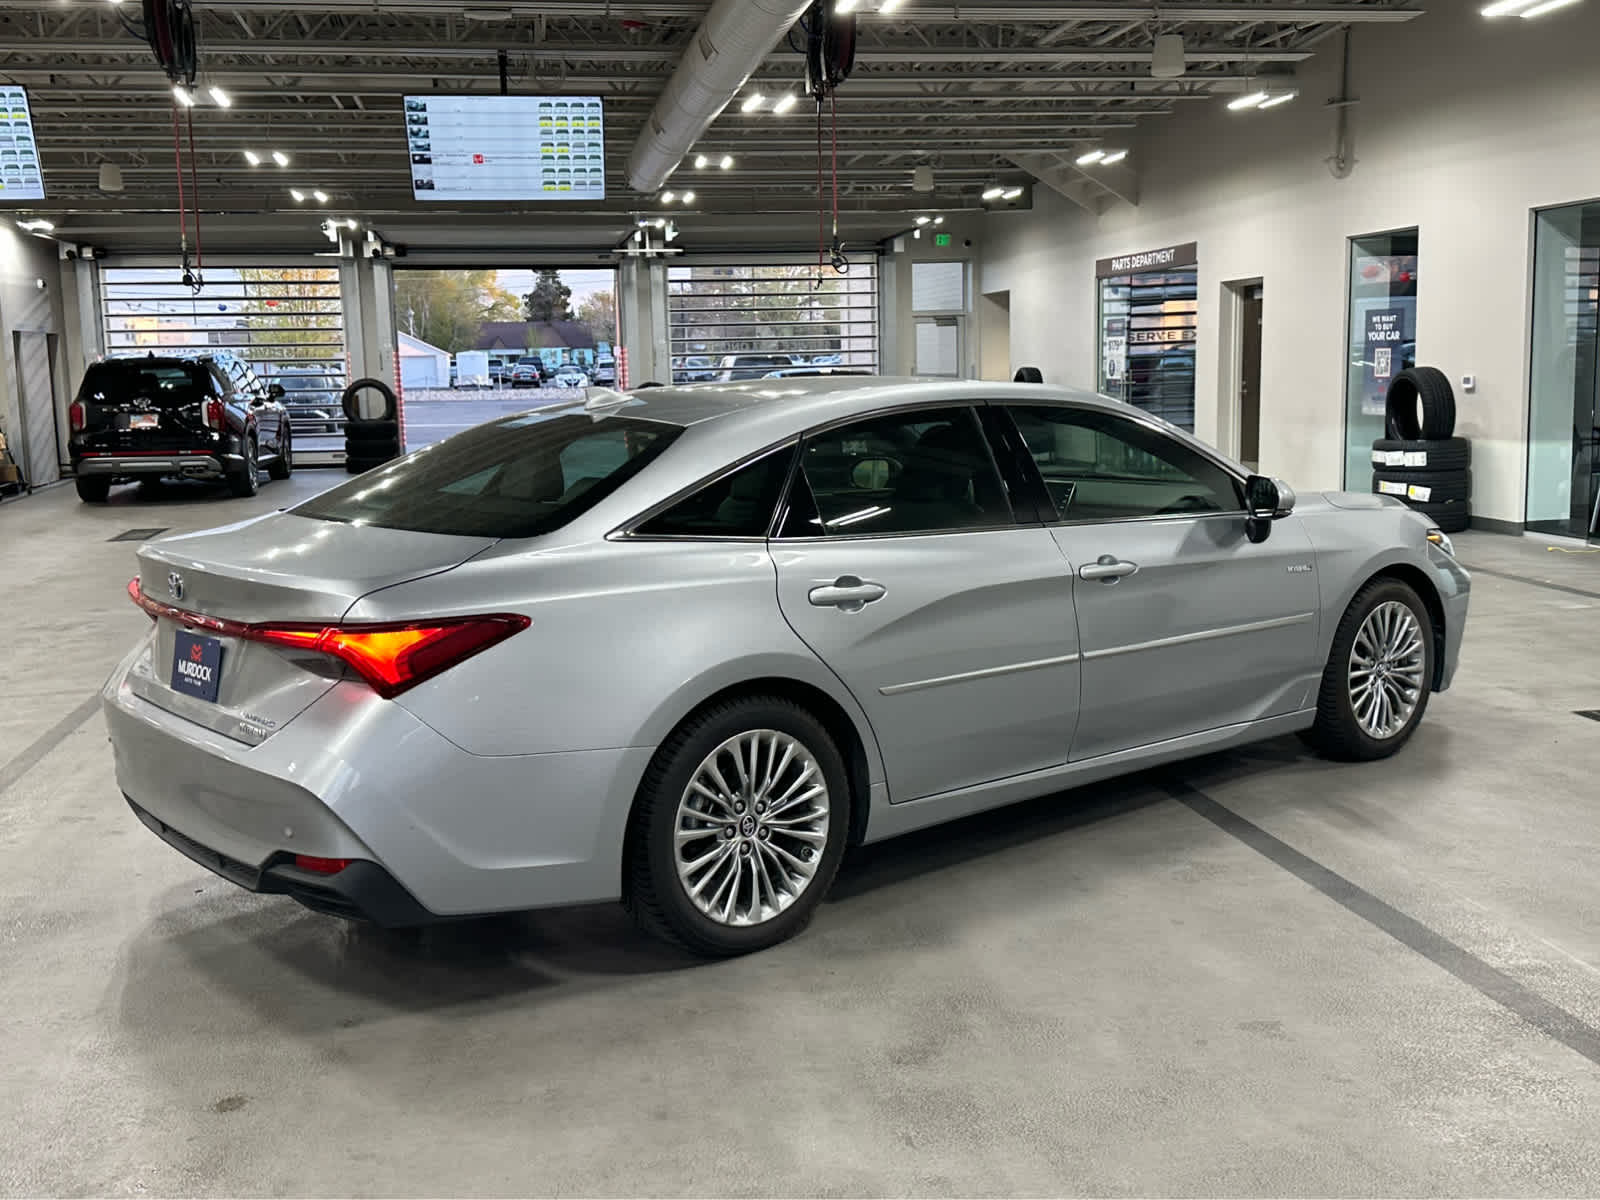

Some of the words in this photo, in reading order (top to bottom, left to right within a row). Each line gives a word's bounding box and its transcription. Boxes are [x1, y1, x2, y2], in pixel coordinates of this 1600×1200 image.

[1112, 257, 1130, 271] PARTS
[1131, 249, 1175, 268] DEPARTMENT
[1368, 331, 1385, 341] YOUR
[1386, 330, 1400, 340] CAR
[177, 659, 212, 682] MURDOCK
